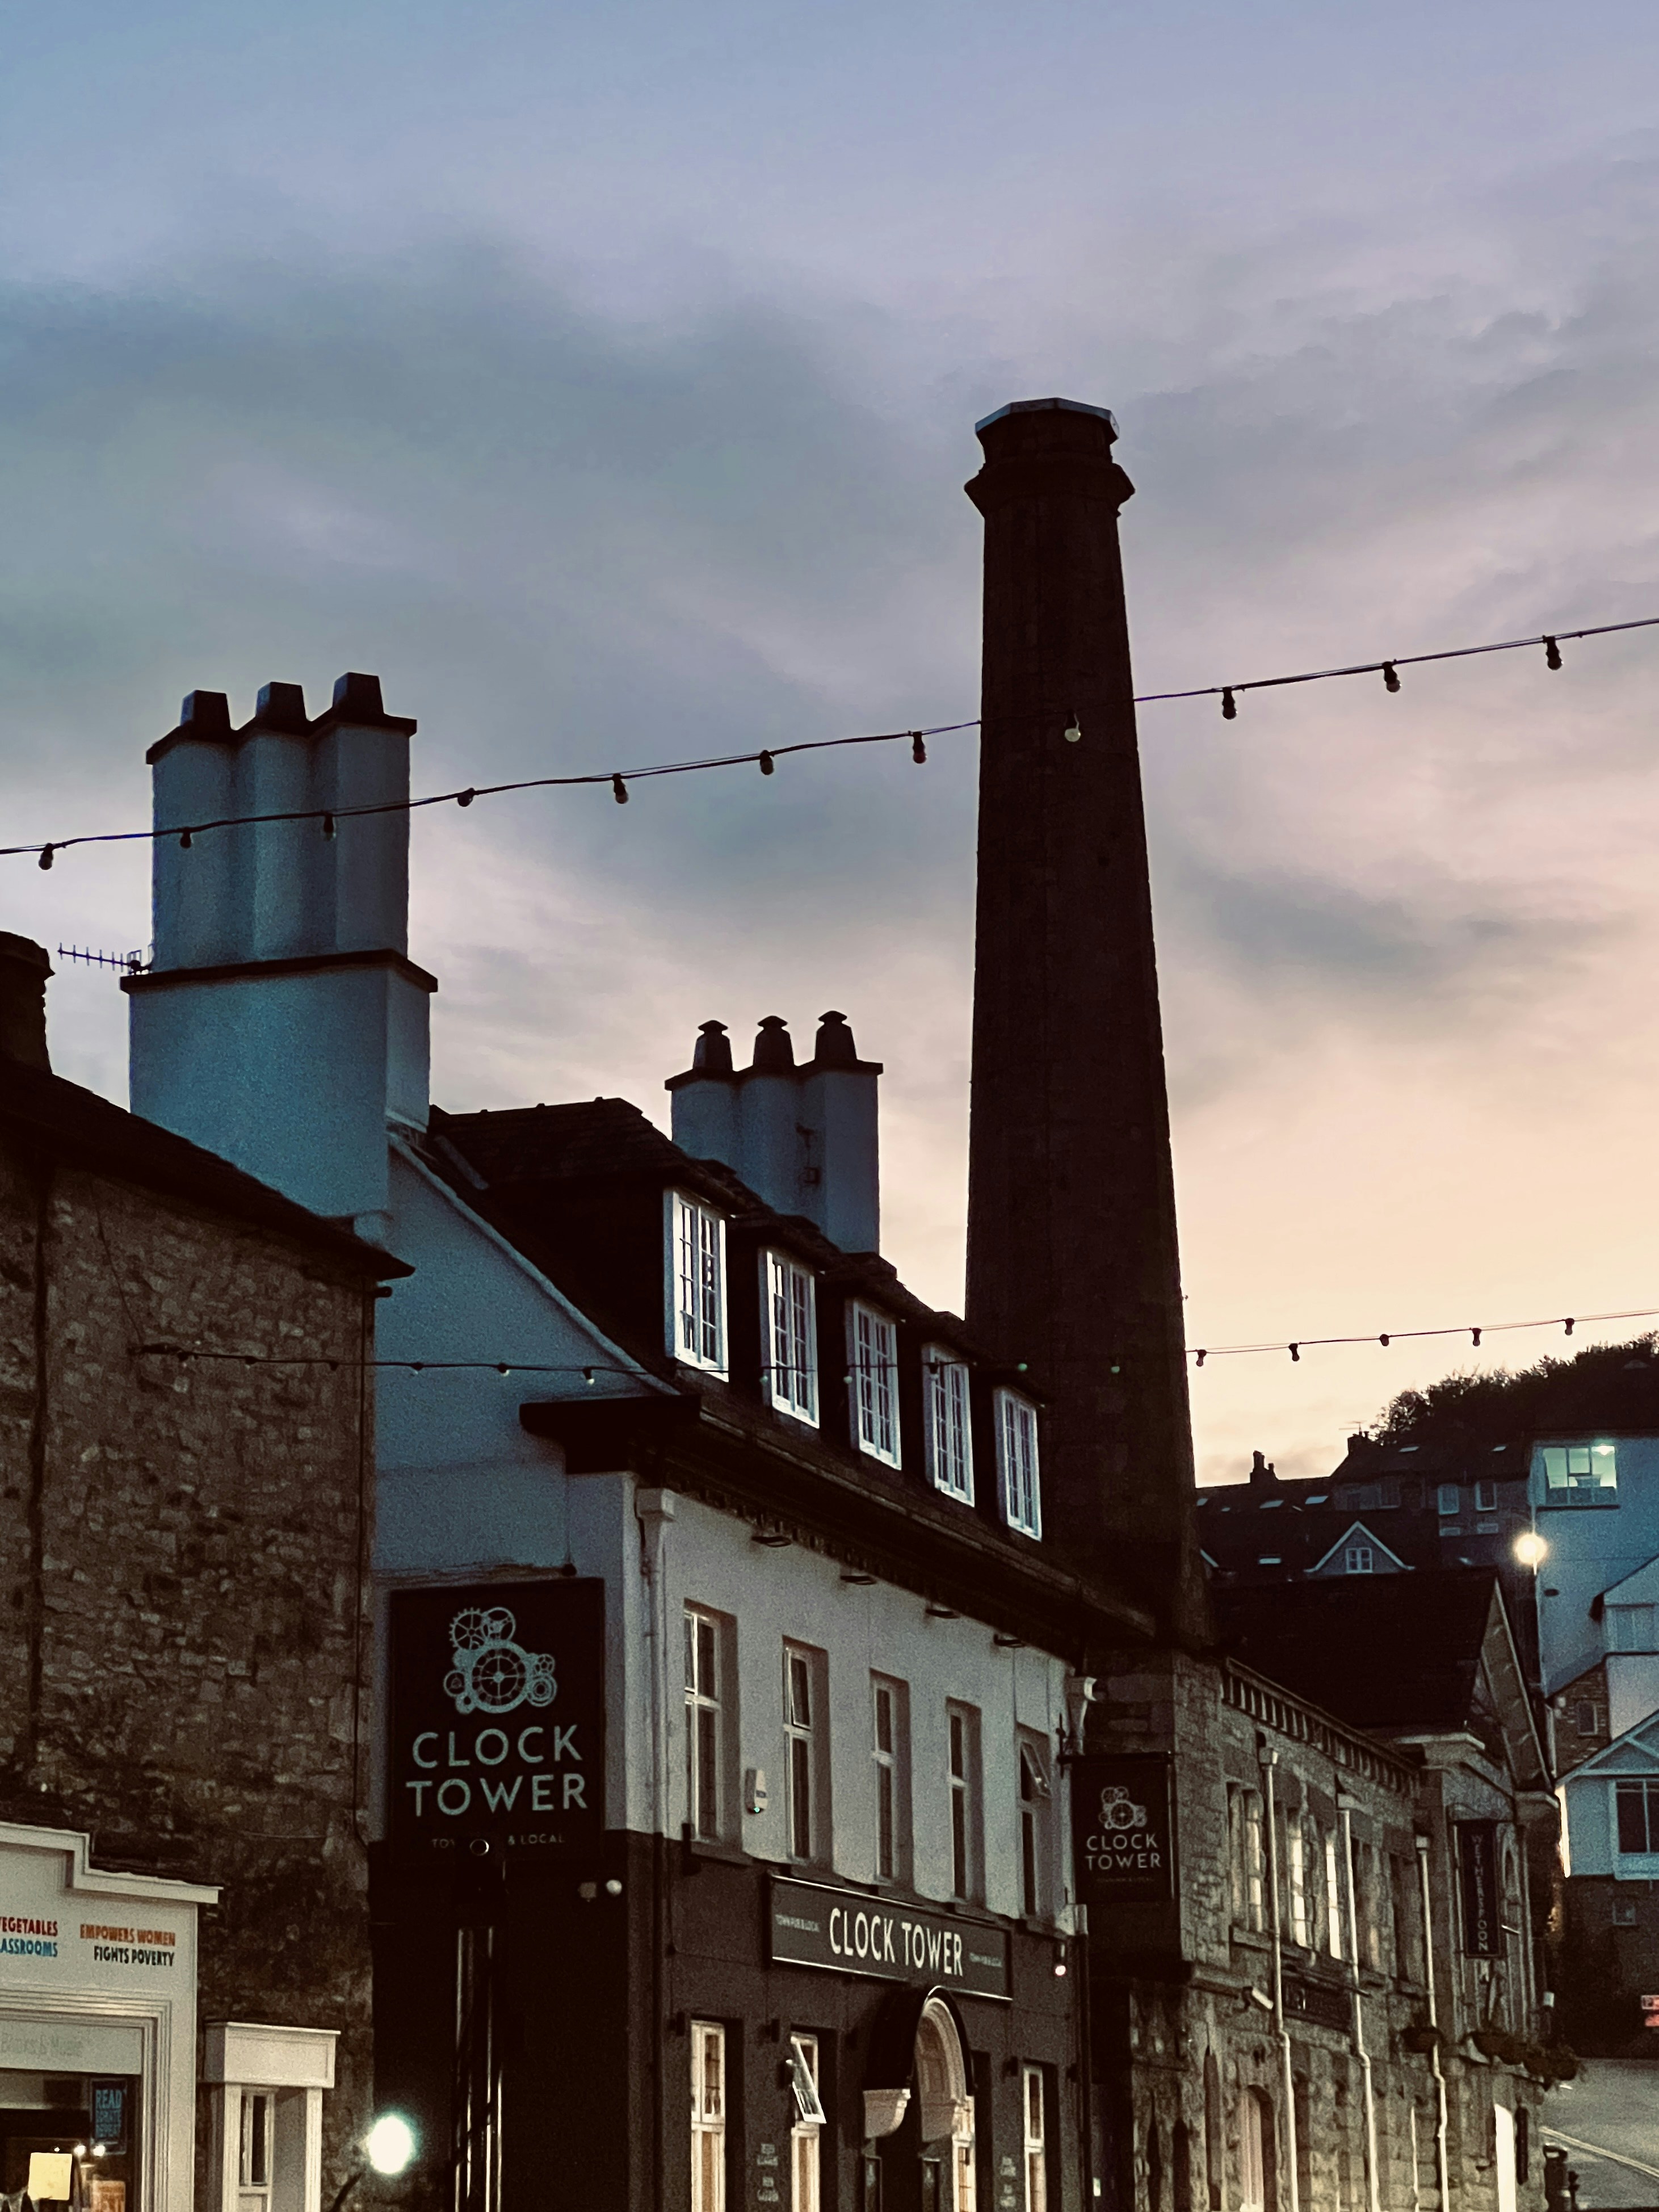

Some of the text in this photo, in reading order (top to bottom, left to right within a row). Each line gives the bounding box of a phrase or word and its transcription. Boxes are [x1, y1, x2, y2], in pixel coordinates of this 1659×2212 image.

[412, 1724, 583, 1769] CLOCK
[405, 1773, 589, 1817] TOWER
[521, 1833, 565, 1845] LOCAL
[1086, 1833, 1158, 1851] CLOCK
[1085, 1853, 1161, 1870] TOWER
[1471, 1834, 1489, 1951] WETHERSPOON
[80, 1924, 175, 1946] EMPOWERS WOMEN
[829, 1907, 963, 1977] CLOCK TOWER
[0, 1938, 58, 1957] ASSROOMS
[94, 1945, 175, 1966] FIGHTS POVERTY
[95, 2090, 123, 2109] READ
